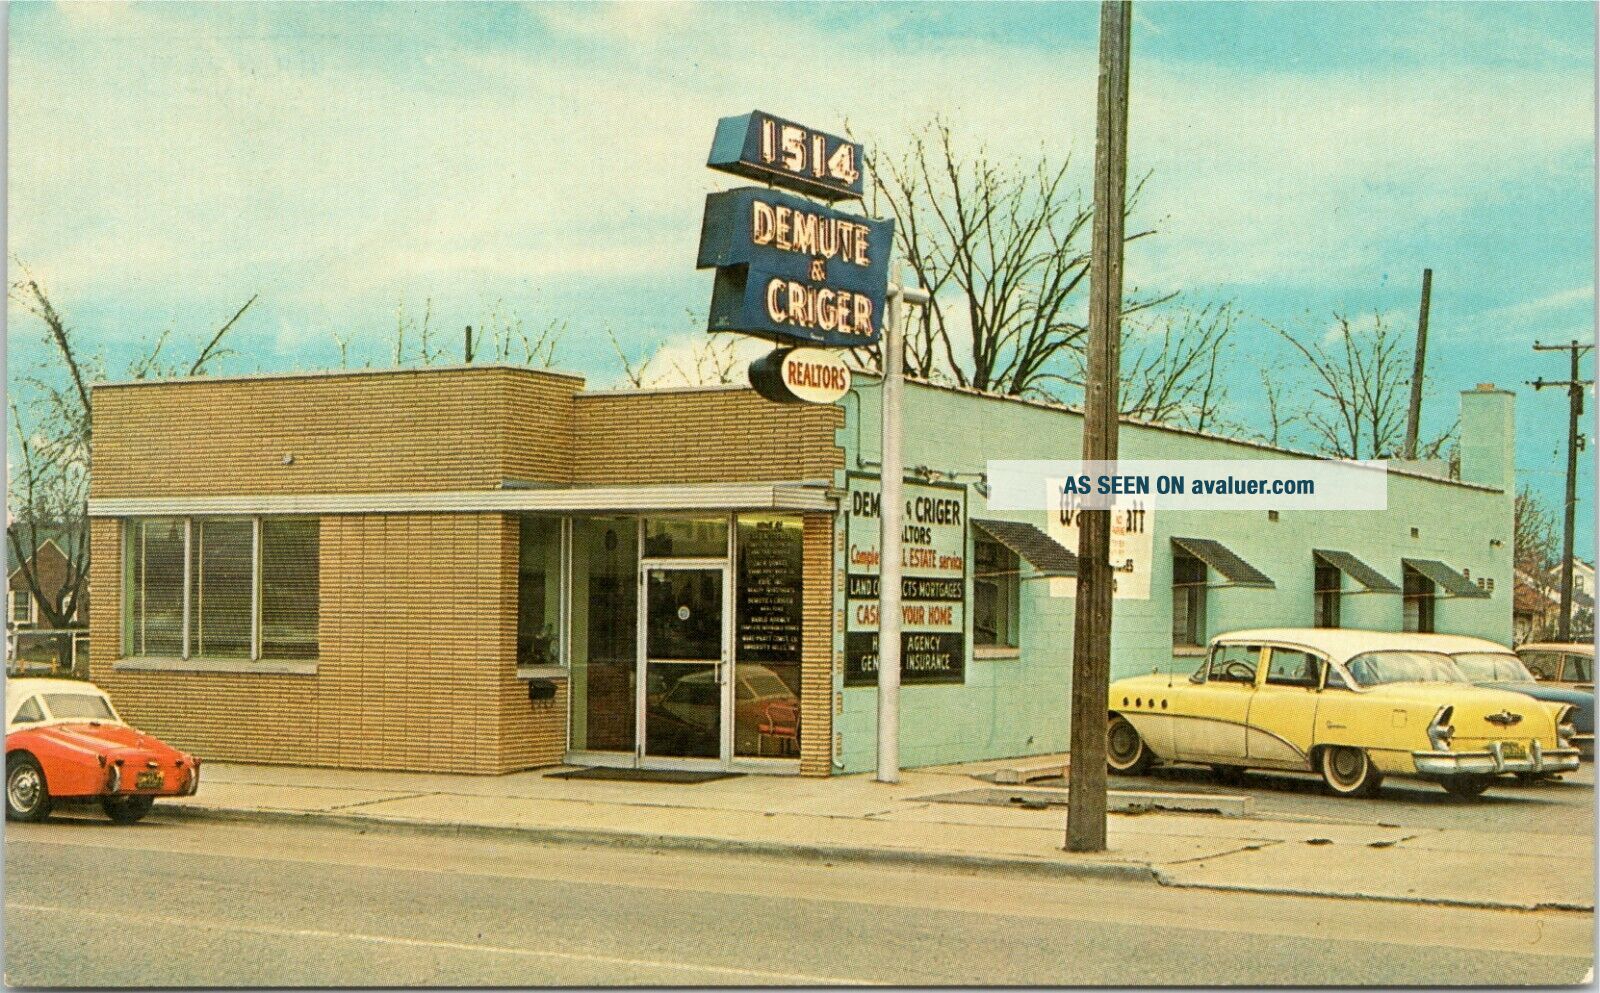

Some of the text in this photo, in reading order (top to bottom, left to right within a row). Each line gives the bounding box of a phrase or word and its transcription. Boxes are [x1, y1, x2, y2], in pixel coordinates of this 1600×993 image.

[761, 118, 860, 186] 1514
[752, 199, 871, 268] DEMUTE
[810, 258, 826, 281] &
[766, 277, 874, 337] CRIGER
[787, 360, 847, 391] REALTORS
[915, 496, 962, 526] CRIGER
[909, 547, 937, 568] ESTATE
[849, 577, 872, 596] LAND
[919, 580, 962, 598] MORTGAGES
[901, 605, 925, 626] YOUR
[927, 605, 953, 626] HOME
[907, 635, 942, 652] AGENCY
[906, 653, 951, 672] INSURANCE
